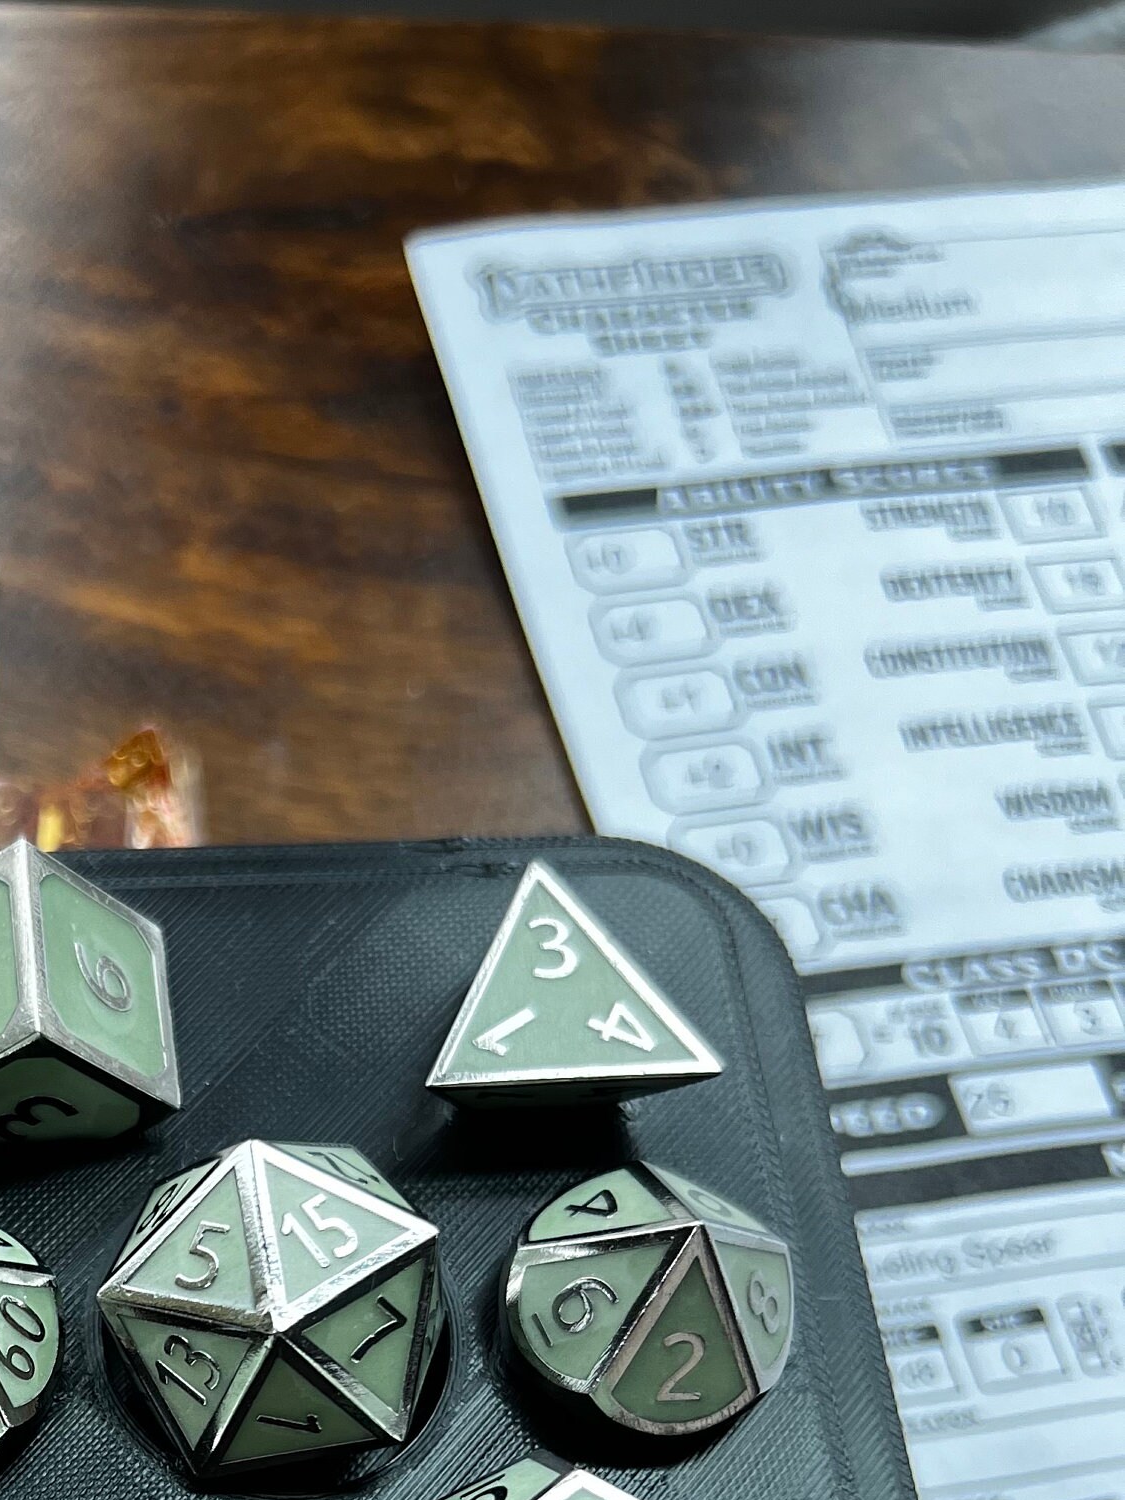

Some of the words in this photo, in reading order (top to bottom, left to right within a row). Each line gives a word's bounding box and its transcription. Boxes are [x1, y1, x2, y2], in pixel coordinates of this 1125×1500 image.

[683, 521, 753, 551] STR
[708, 587, 782, 622] DEX
[734, 658, 809, 694] CON
[864, 637, 1053, 678] CONSTITUTION
[768, 733, 832, 768] INT
[898, 707, 1083, 752] INTELLIGENCE
[789, 808, 864, 844] WIS
[996, 783, 1113, 822] WISDOM
[820, 884, 899, 924] CHA
[528, 917, 579, 980] 3
[902, 950, 1044, 991] CLASS
[472, 1007, 536, 1057] 1
[587, 1002, 656, 1053] 4
[280, 1193, 359, 1268] 15
[564, 1188, 619, 1220] 4
[175, 1219, 231, 1290] 5
[350, 1294, 408, 1364] 7
[747, 1268, 780, 1335] 8
[155, 1333, 222, 1407] 13
[656, 1331, 706, 1404] 2
[256, 1412, 323, 1434] 1
